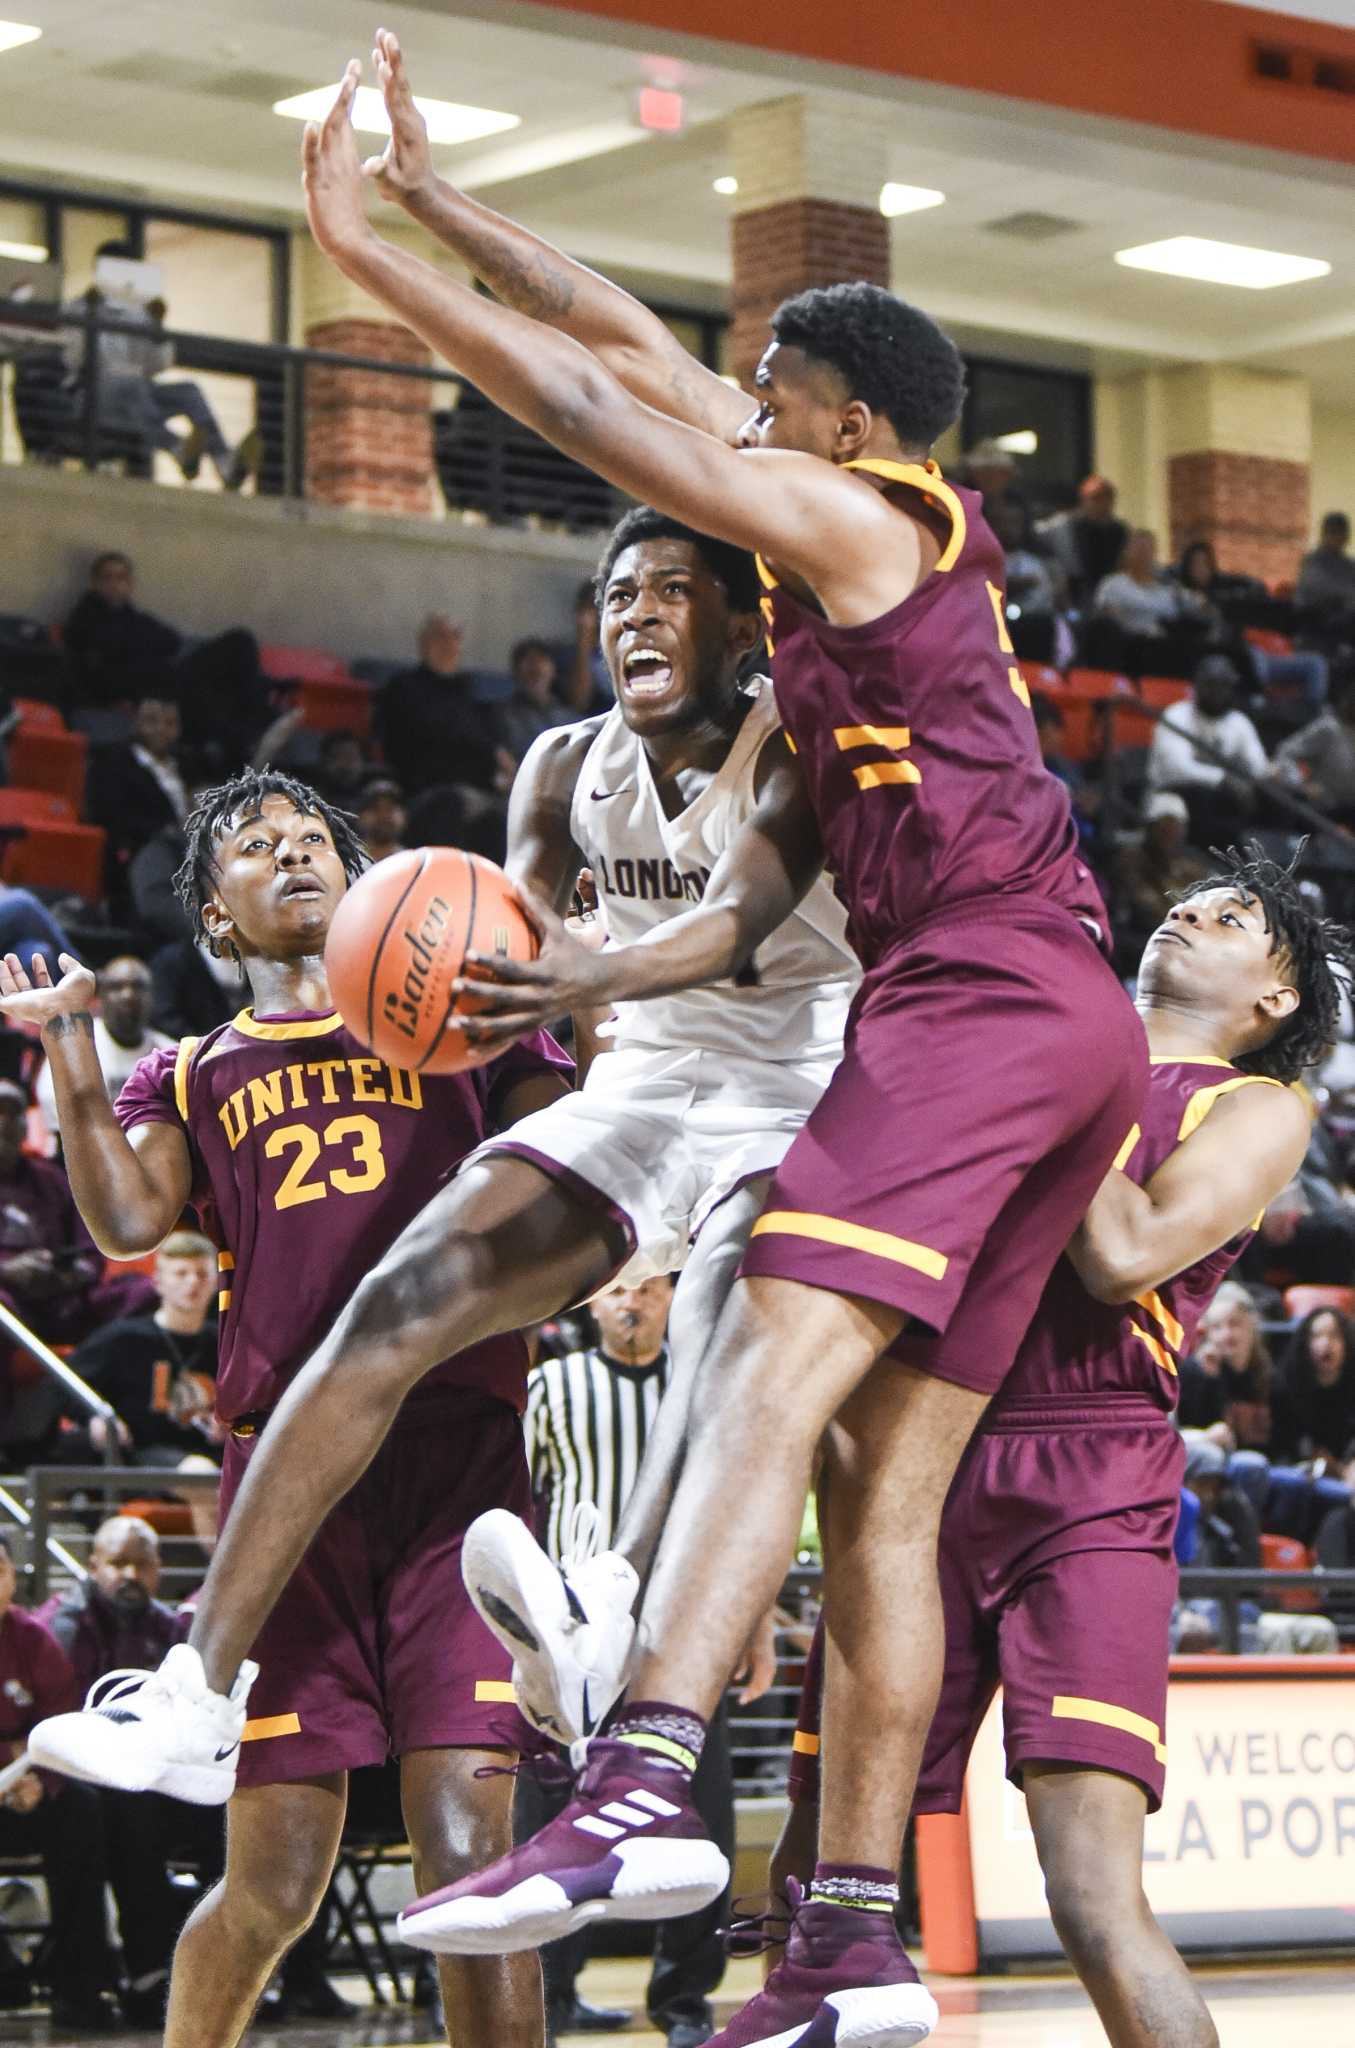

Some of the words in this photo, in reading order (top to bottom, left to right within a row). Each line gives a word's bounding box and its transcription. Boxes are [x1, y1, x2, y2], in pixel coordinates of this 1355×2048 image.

[383, 896, 451, 1039] Baden
[218, 1058, 423, 1151] UNITED
[265, 1114, 386, 1210] 23
[1195, 1731, 1355, 1776] WELCO
